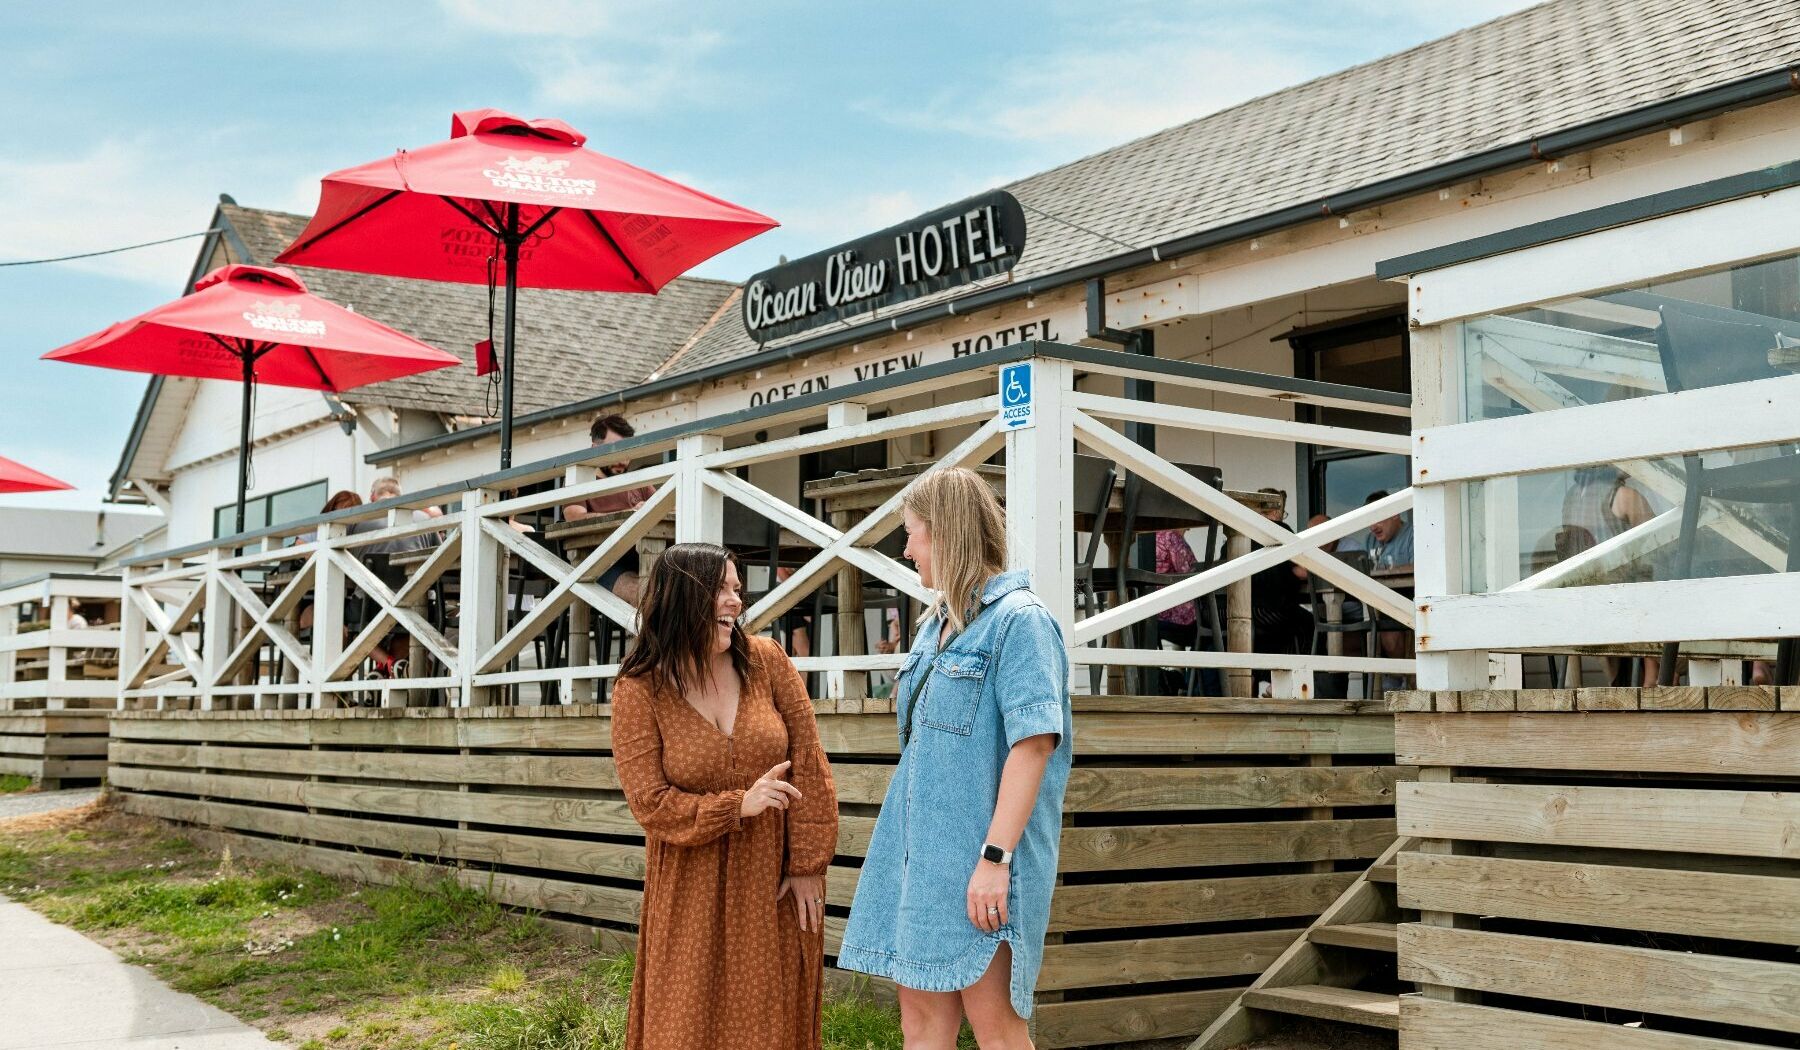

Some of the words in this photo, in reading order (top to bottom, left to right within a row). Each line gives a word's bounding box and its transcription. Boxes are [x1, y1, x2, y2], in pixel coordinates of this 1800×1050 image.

[483, 169, 596, 190] CARLTON
[491, 179, 595, 195] DRAUGHT
[746, 280, 817, 330] Ocean
[825, 250, 886, 307] View
[895, 205, 1007, 285] HOTEL
[750, 375, 829, 408] OCEAN
[854, 351, 923, 382] VIEW
[952, 318, 1059, 358] HOTEL
[1003, 406, 1031, 420] ACCESS
